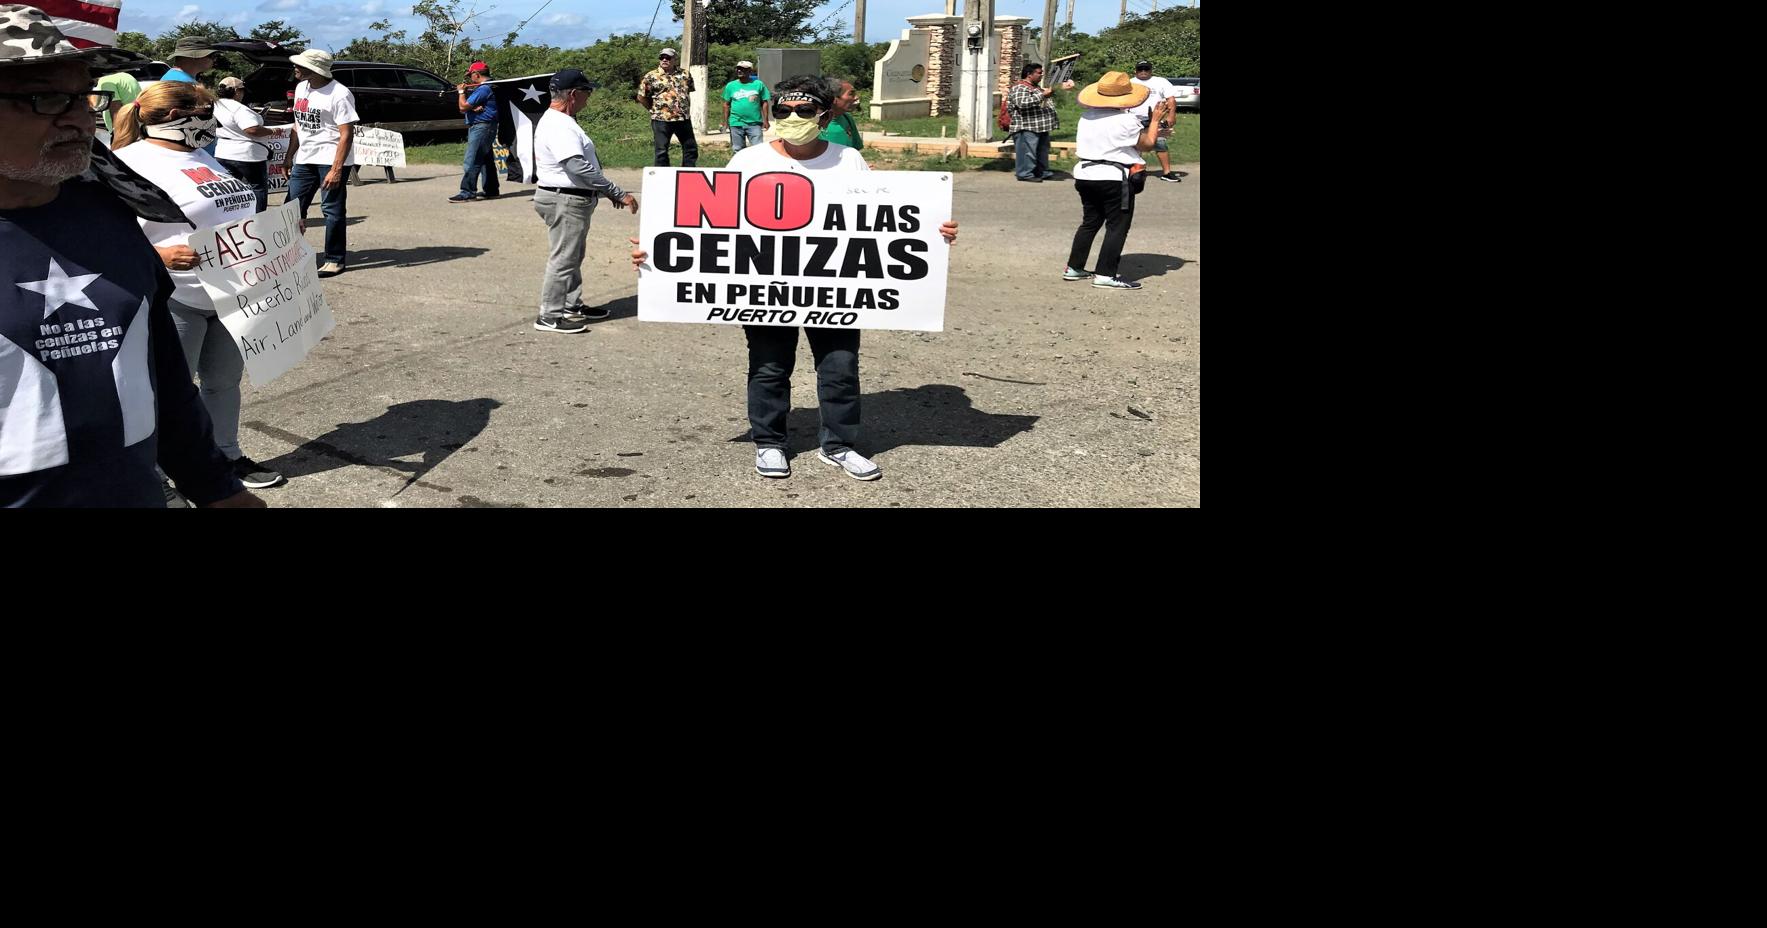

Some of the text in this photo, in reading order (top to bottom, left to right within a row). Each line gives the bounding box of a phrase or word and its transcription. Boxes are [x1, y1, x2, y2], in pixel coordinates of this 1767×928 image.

[215, 193, 256, 208] EN PEÑUELAS
[223, 205, 240, 213] PUERTO
[673, 170, 921, 233] NO A LAS
[653, 231, 929, 281] CENIZAS
[236, 279, 293, 318] Puerto
[676, 281, 900, 310] EN PEÑUELAS
[40, 317, 105, 336] No a las
[706, 307, 858, 326] PUERTO RICO
[35, 325, 123, 349] cenizas en
[40, 339, 119, 361] Peñuelas
